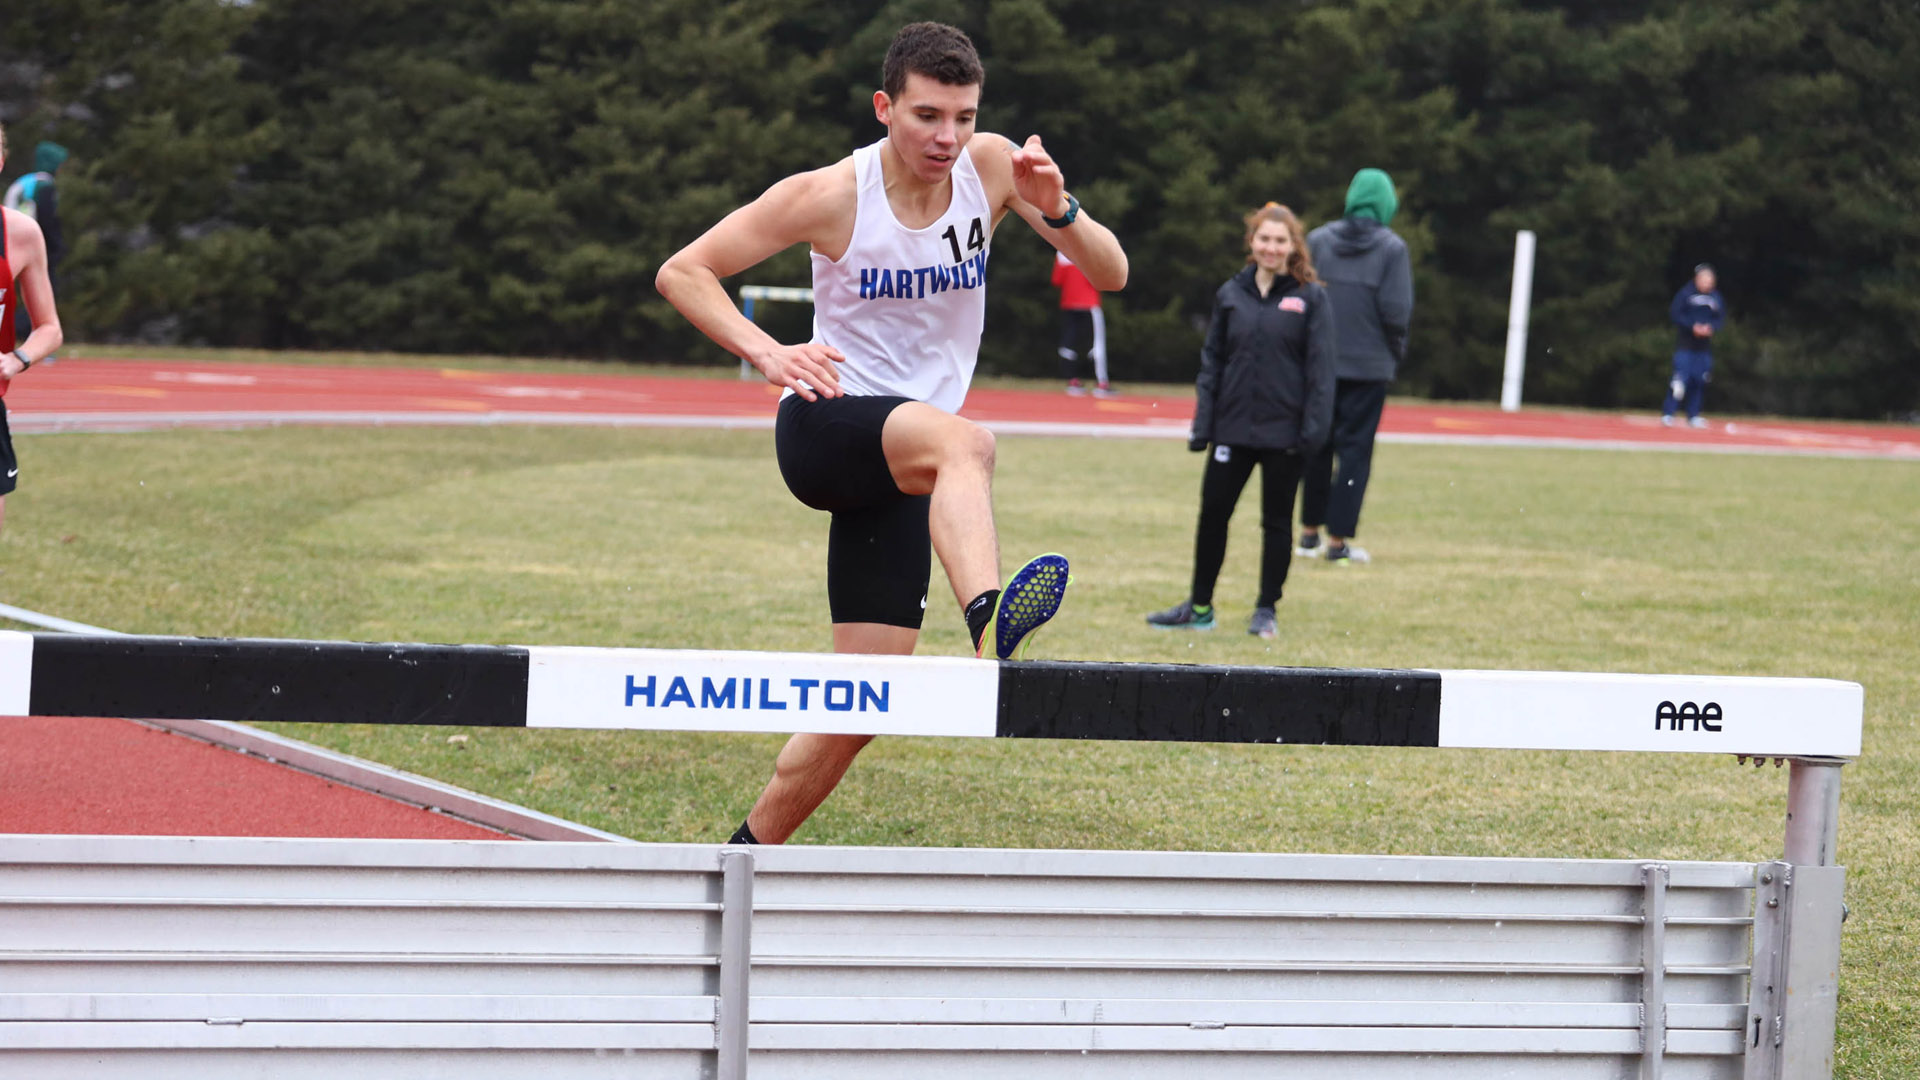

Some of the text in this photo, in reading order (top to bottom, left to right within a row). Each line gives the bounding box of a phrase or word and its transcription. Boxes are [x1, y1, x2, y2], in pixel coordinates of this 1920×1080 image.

[941, 217, 985, 263] 14
[860, 249, 985, 300] HARTWICK
[625, 675, 889, 712] HAMILTON
